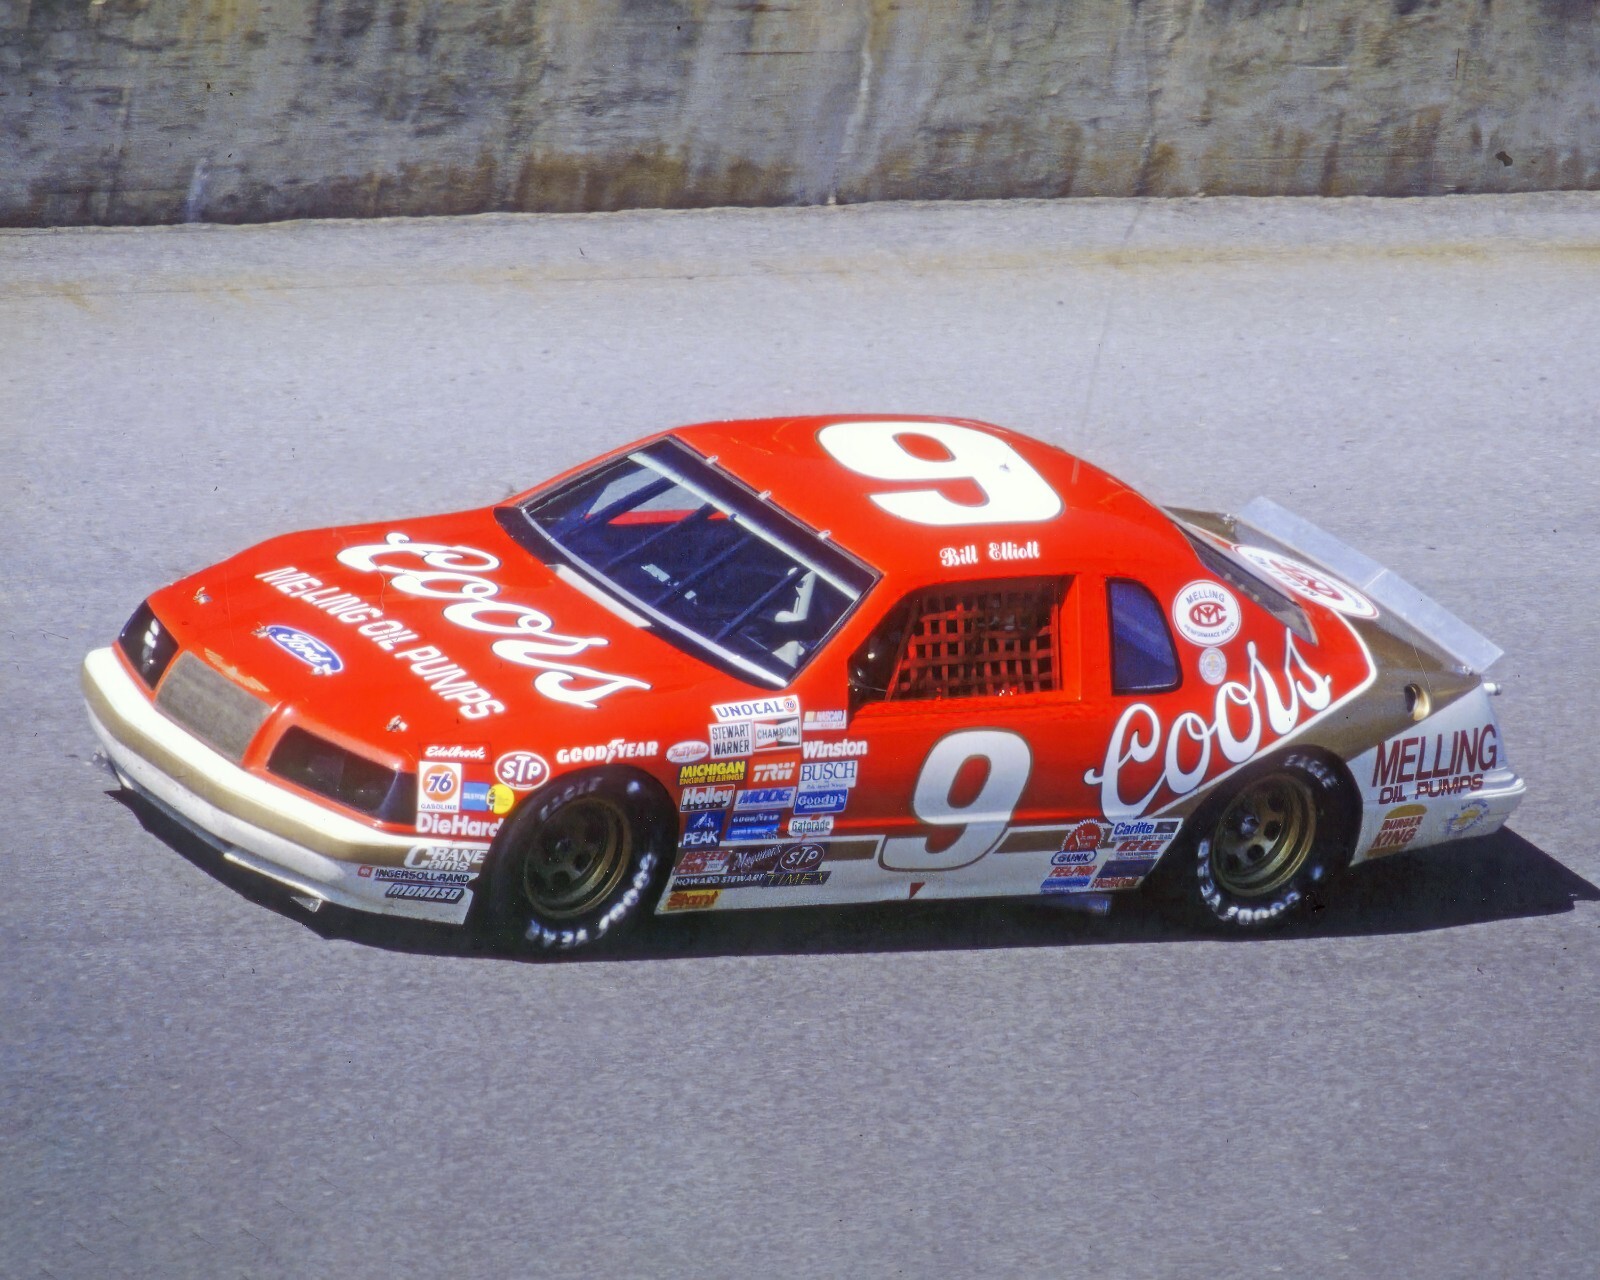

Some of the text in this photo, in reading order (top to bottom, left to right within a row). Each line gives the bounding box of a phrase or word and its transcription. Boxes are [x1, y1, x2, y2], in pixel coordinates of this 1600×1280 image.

[815, 420, 1066, 526] 9
[939, 540, 1040, 567] Bill Elliott
[1186, 589, 1225, 605] MELLING
[336, 531, 653, 708] Coors
[255, 566, 507, 720] MELLING OIL PUMPS
[275, 627, 335, 670] Ford
[716, 700, 784, 718] UNOCAL
[711, 724, 750, 741] STEWART
[756, 726, 798, 740] CHAMPION
[1084, 627, 1332, 823] Coors
[425, 746, 486, 759] Edelbrock
[556, 739, 659, 764] GOODYEAR
[713, 739, 750, 756] WARNER
[802, 739, 868, 759] Winston
[1372, 724, 1497, 787] MELLING
[502, 755, 542, 782] STP
[680, 761, 746, 778] MICHIGAN
[753, 761, 796, 782] TRW
[801, 762, 856, 781] BUSCH
[426, 772, 452, 793] 76
[1378, 774, 1484, 804] OIL PUMPS
[420, 803, 457, 811] GASOLINE
[682, 787, 734, 807] Holley
[797, 793, 845, 806] Goody's
[878, 726, 1033, 872] 9
[792, 820, 831, 833] Gatorade
[1114, 822, 1155, 835] Carlite
[1382, 815, 1424, 831] BURGER
[683, 831, 720, 846] PEAK
[1371, 828, 1418, 848] KING
[404, 845, 489, 869] CRANE
[786, 845, 819, 865] STP
